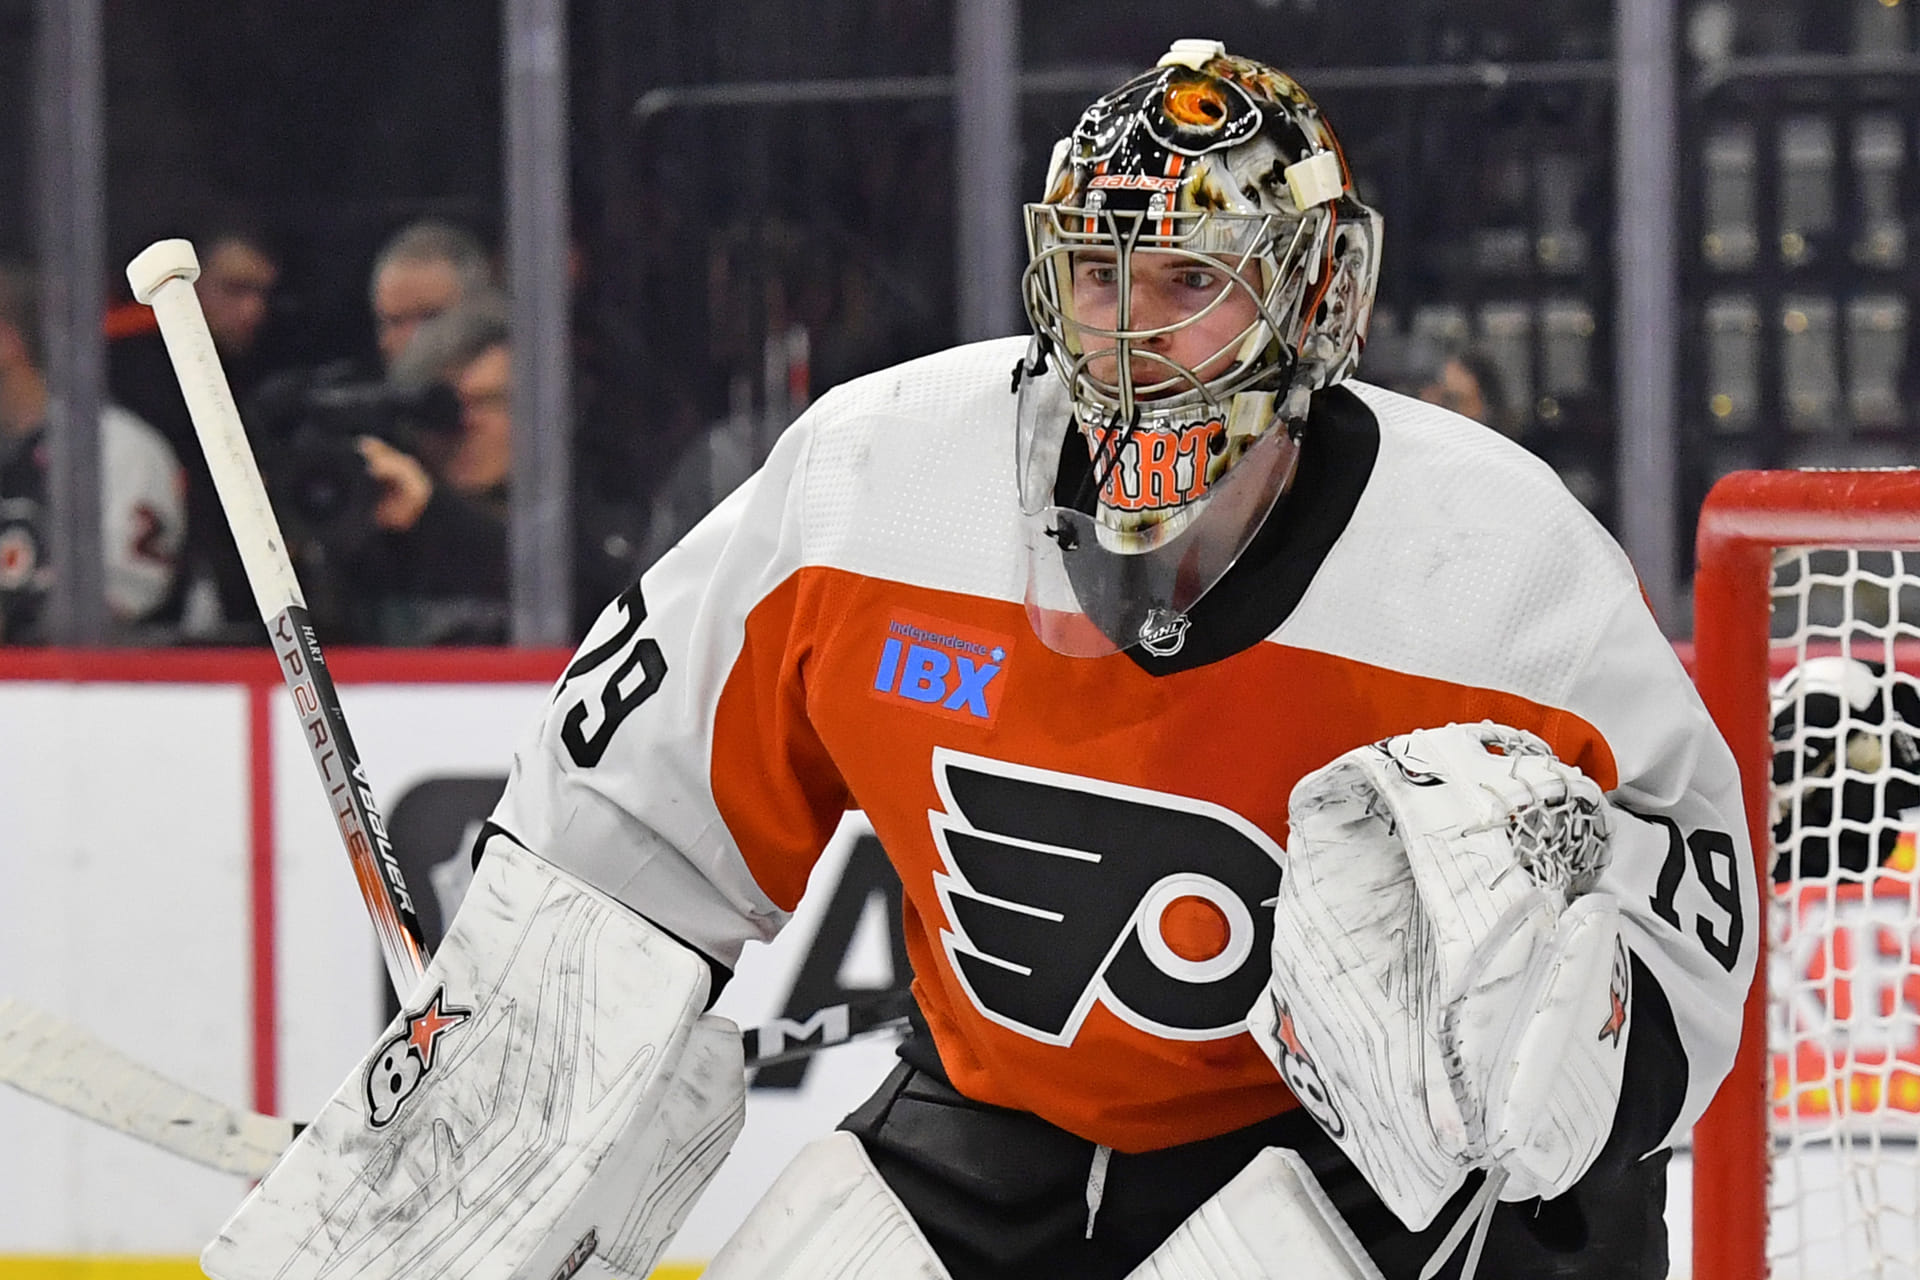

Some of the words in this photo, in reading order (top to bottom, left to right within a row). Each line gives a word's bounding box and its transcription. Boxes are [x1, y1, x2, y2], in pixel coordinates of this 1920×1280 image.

[1081, 420, 1223, 509] ART
[302, 624, 325, 665] HART
[874, 637, 1002, 719] IBX
[1613, 801, 1744, 973] 79
